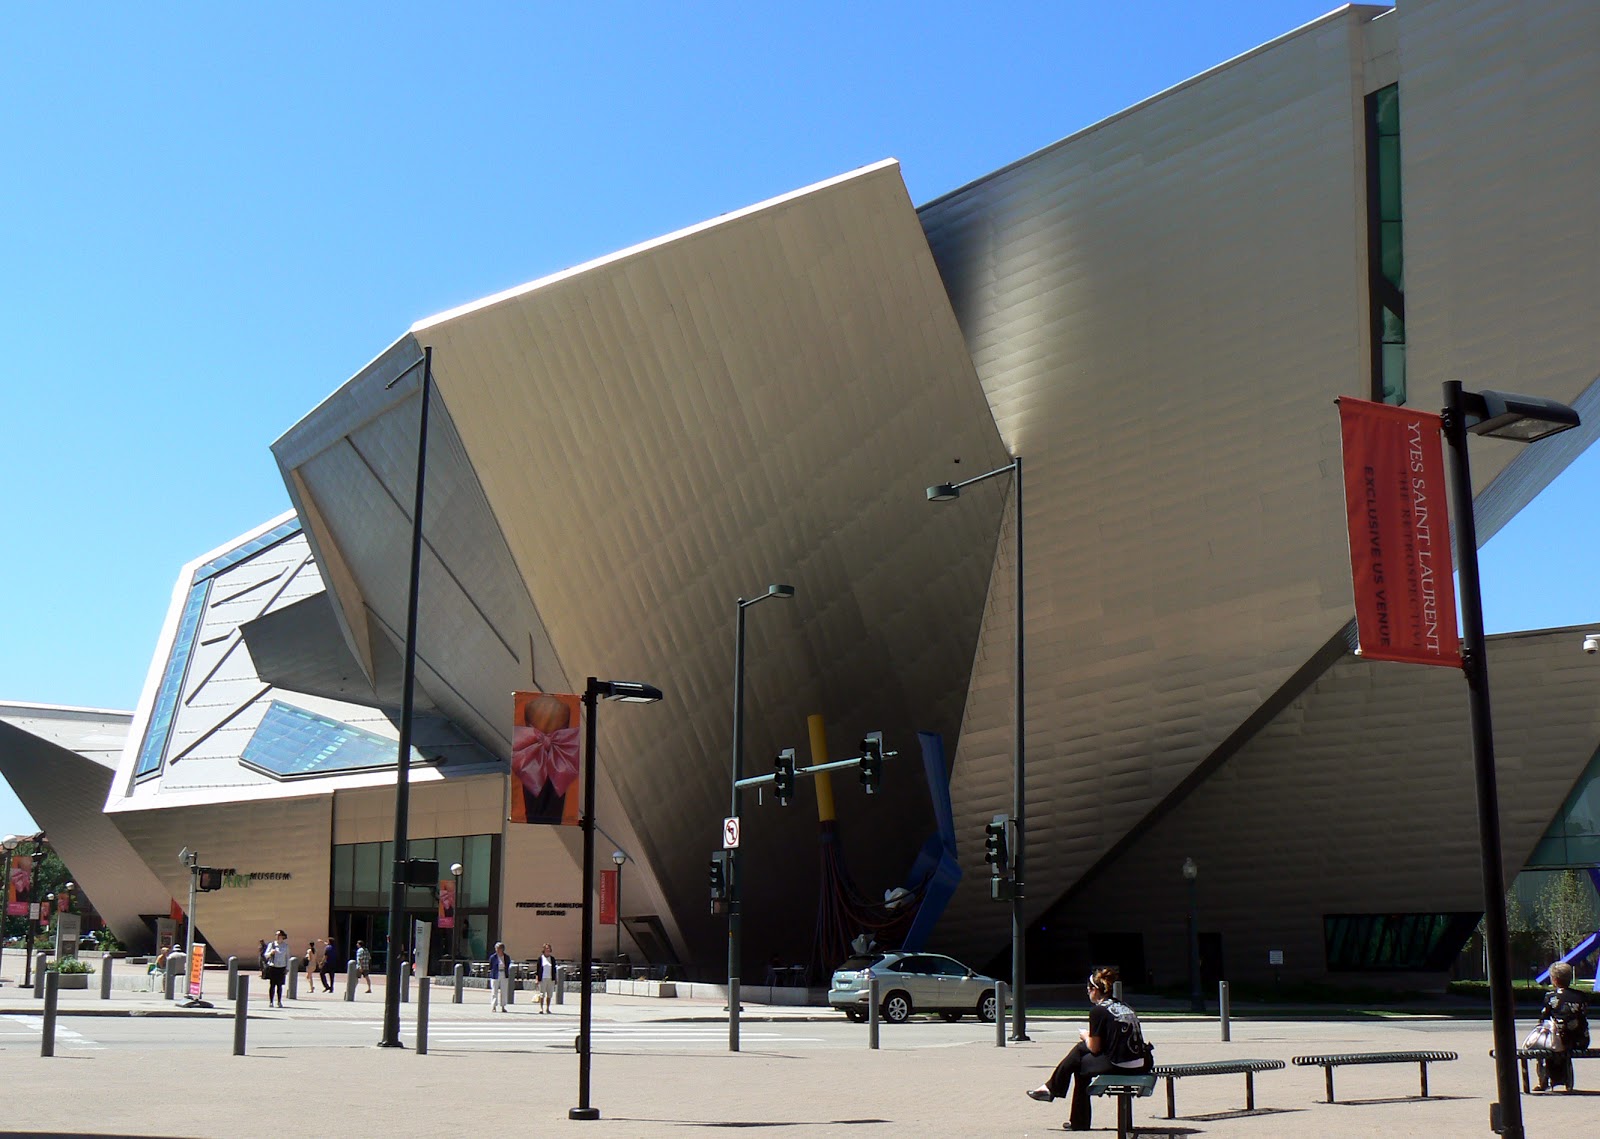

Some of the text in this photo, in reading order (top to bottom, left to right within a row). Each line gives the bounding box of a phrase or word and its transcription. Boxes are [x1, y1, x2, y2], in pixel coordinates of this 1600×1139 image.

[1364, 466, 1390, 647] EXCLUSIVE US VENUE
[1407, 421, 1440, 655] YVES SAINT LAURENT
[222, 874, 251, 889] ART
[249, 872, 292, 881] MUSEUM
